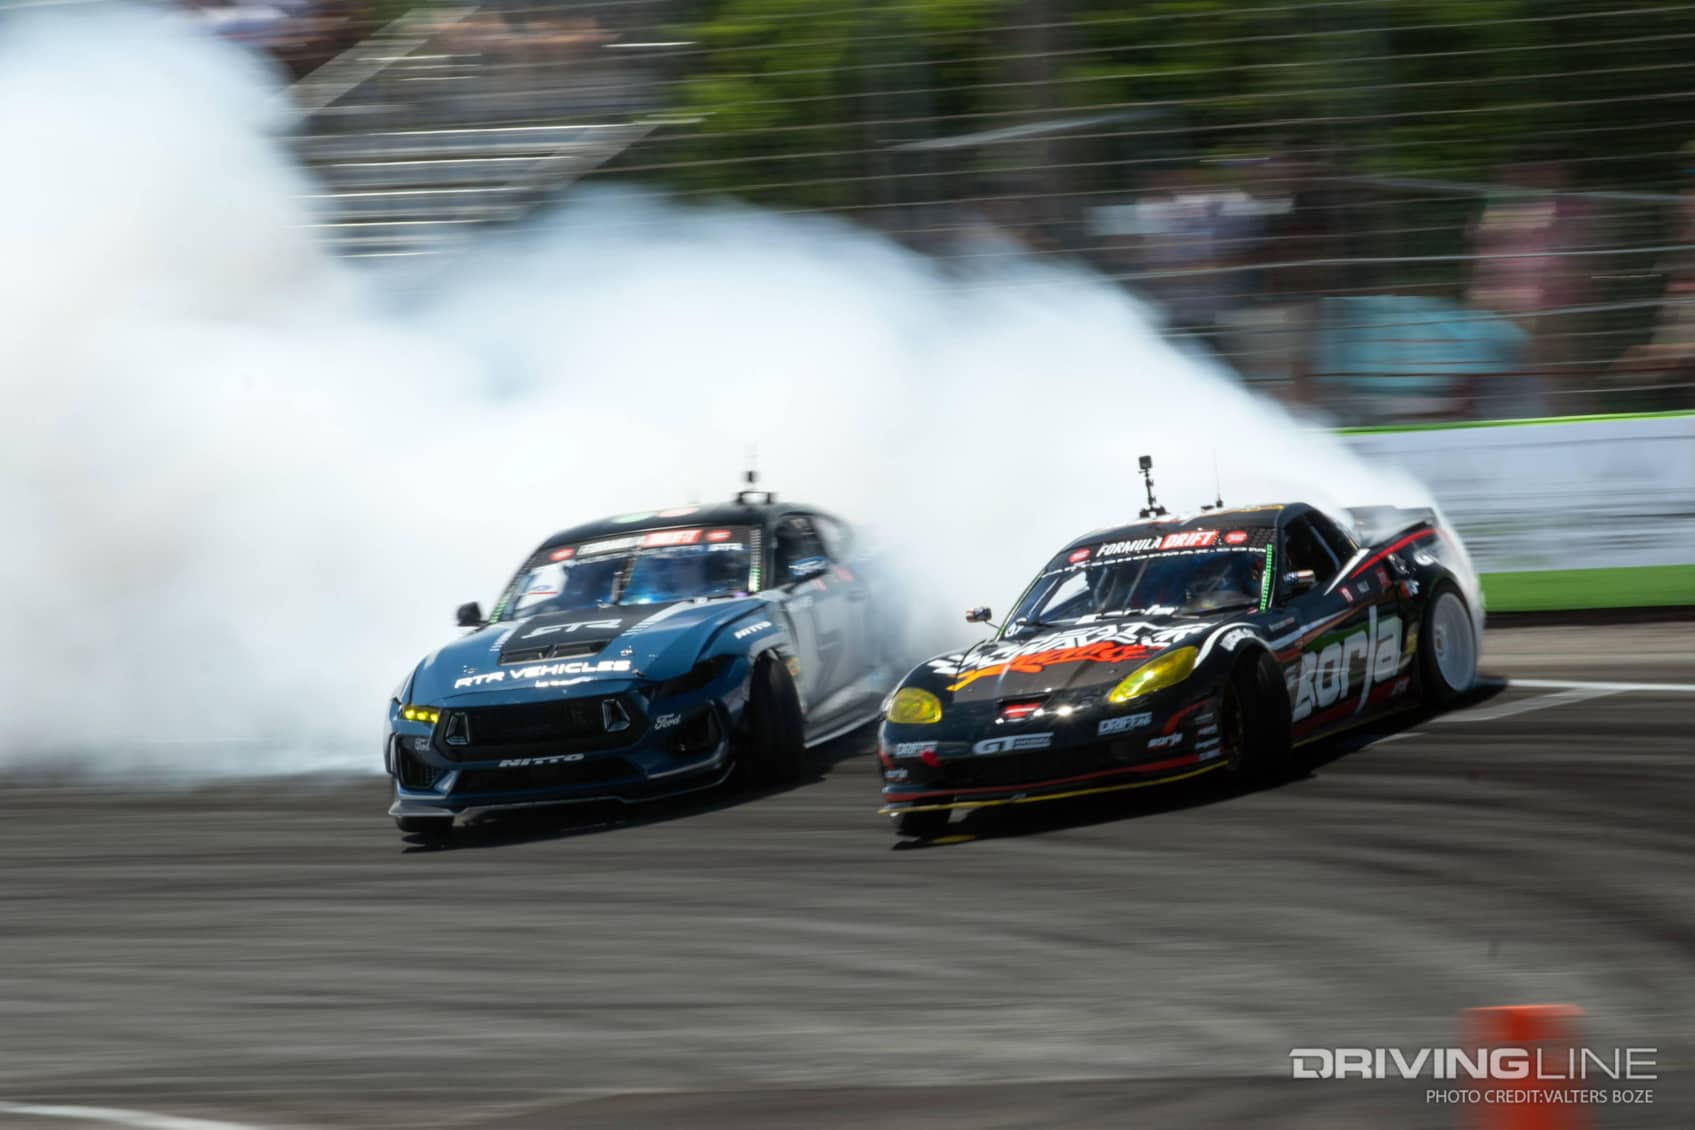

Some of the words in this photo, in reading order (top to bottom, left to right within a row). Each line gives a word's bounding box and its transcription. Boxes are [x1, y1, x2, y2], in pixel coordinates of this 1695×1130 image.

[1096, 536, 1163, 557] FORMULA
[1163, 531, 1218, 548] DRIFT
[454, 671, 506, 688] RTR
[509, 660, 632, 680] VEHICLES
[654, 713, 680, 730] Ford
[498, 753, 584, 768] NITTO
